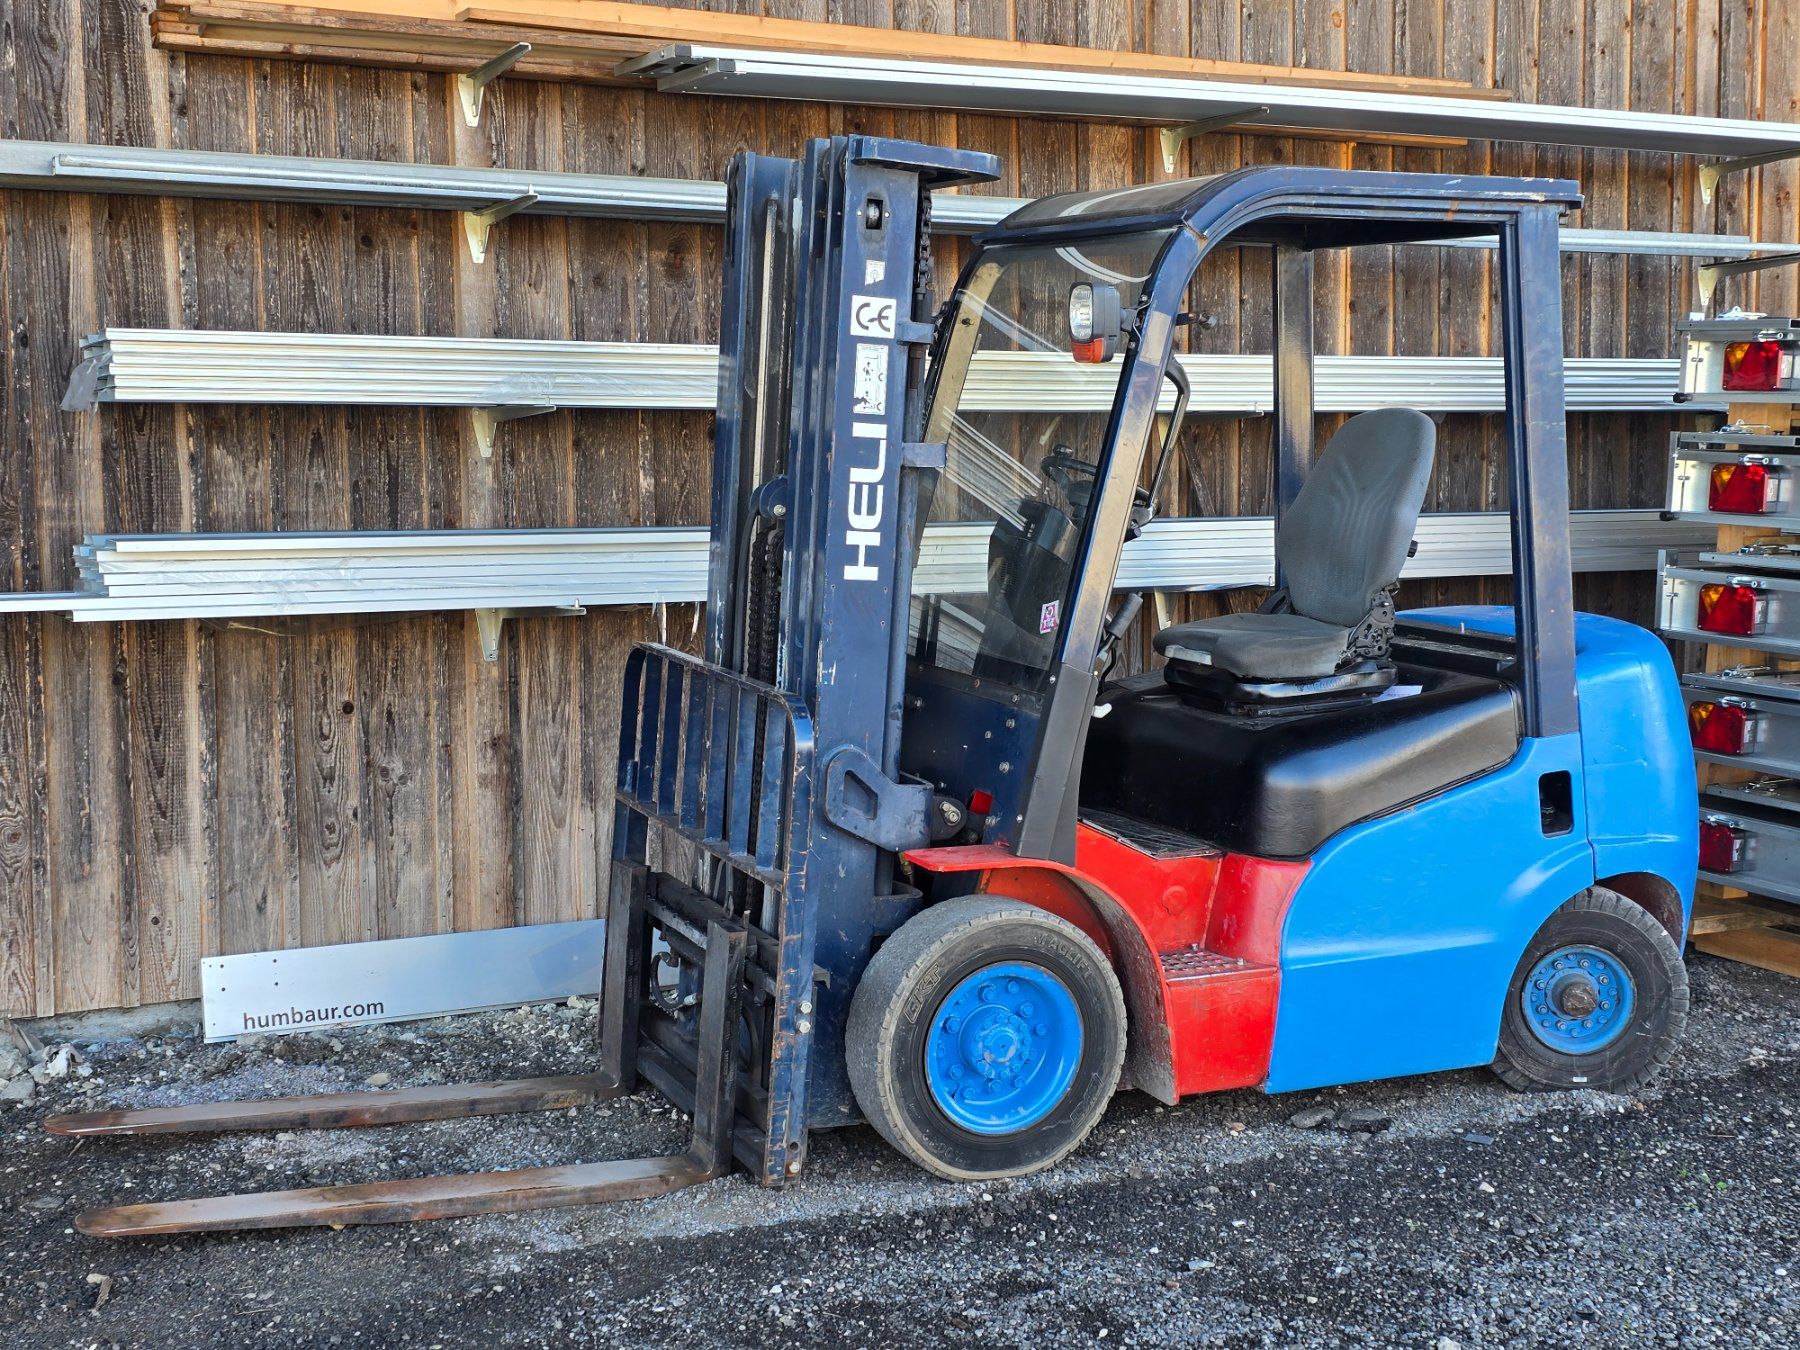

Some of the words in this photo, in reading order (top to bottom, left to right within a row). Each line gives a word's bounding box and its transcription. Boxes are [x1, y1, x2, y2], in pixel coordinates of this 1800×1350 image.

[856, 302, 892, 332] CE
[843, 422, 888, 581] HELI
[243, 1001, 385, 1030] humbaur.com
